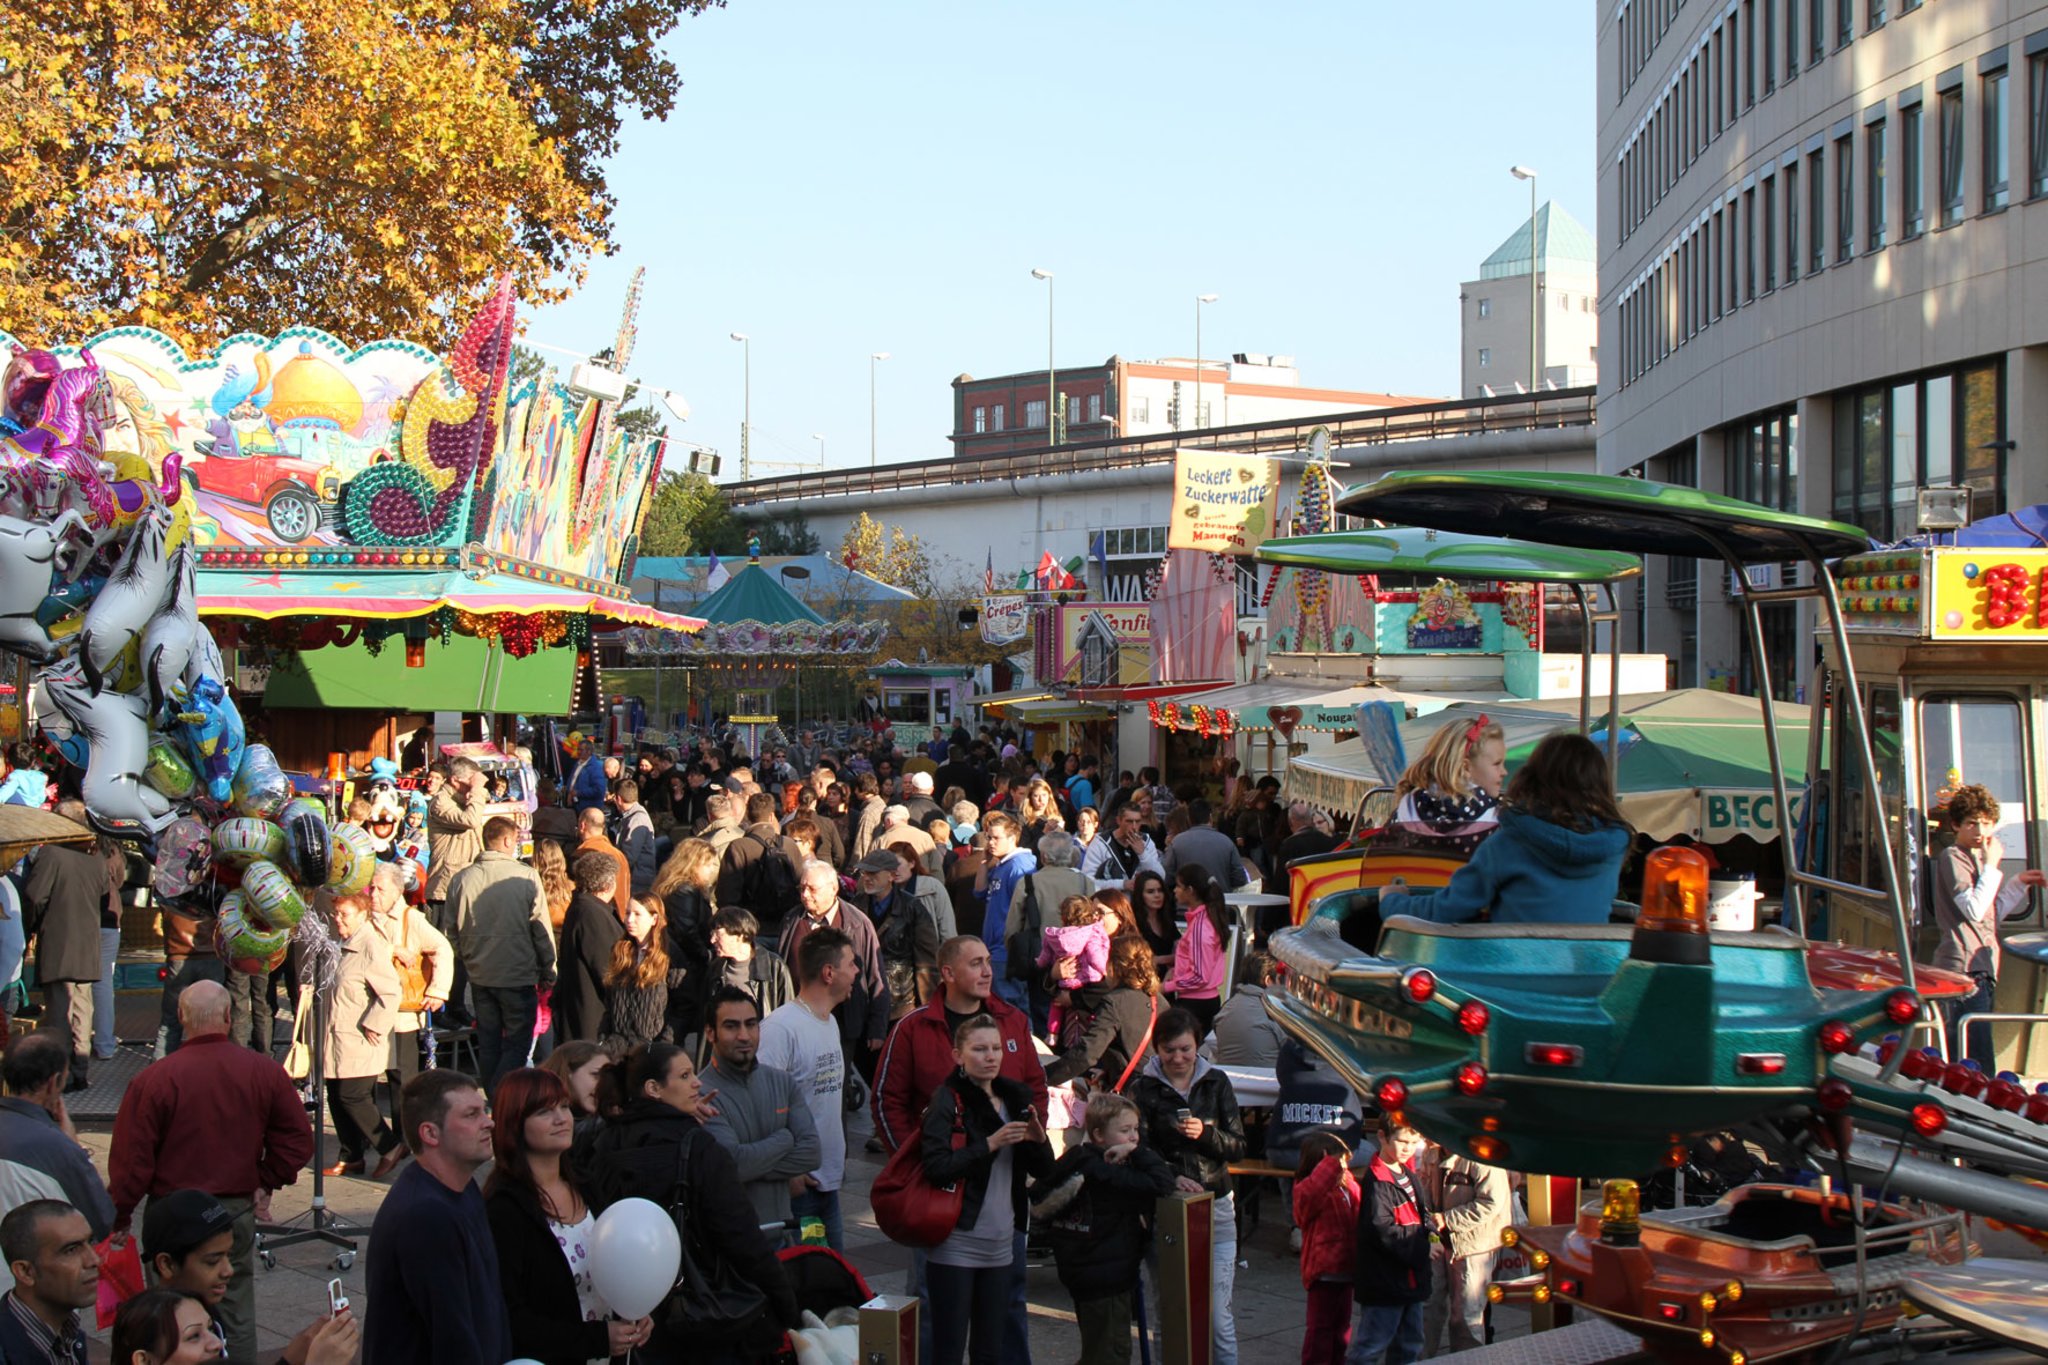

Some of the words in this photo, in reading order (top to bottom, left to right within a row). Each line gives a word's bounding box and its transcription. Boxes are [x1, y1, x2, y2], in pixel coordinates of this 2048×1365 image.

[1188, 467, 1232, 485] Leckere
[1185, 485, 1267, 505] Zuckerwatte
[1193, 531, 1245, 547] Mandeln
[1282, 1103, 1343, 1125] MICKEY
